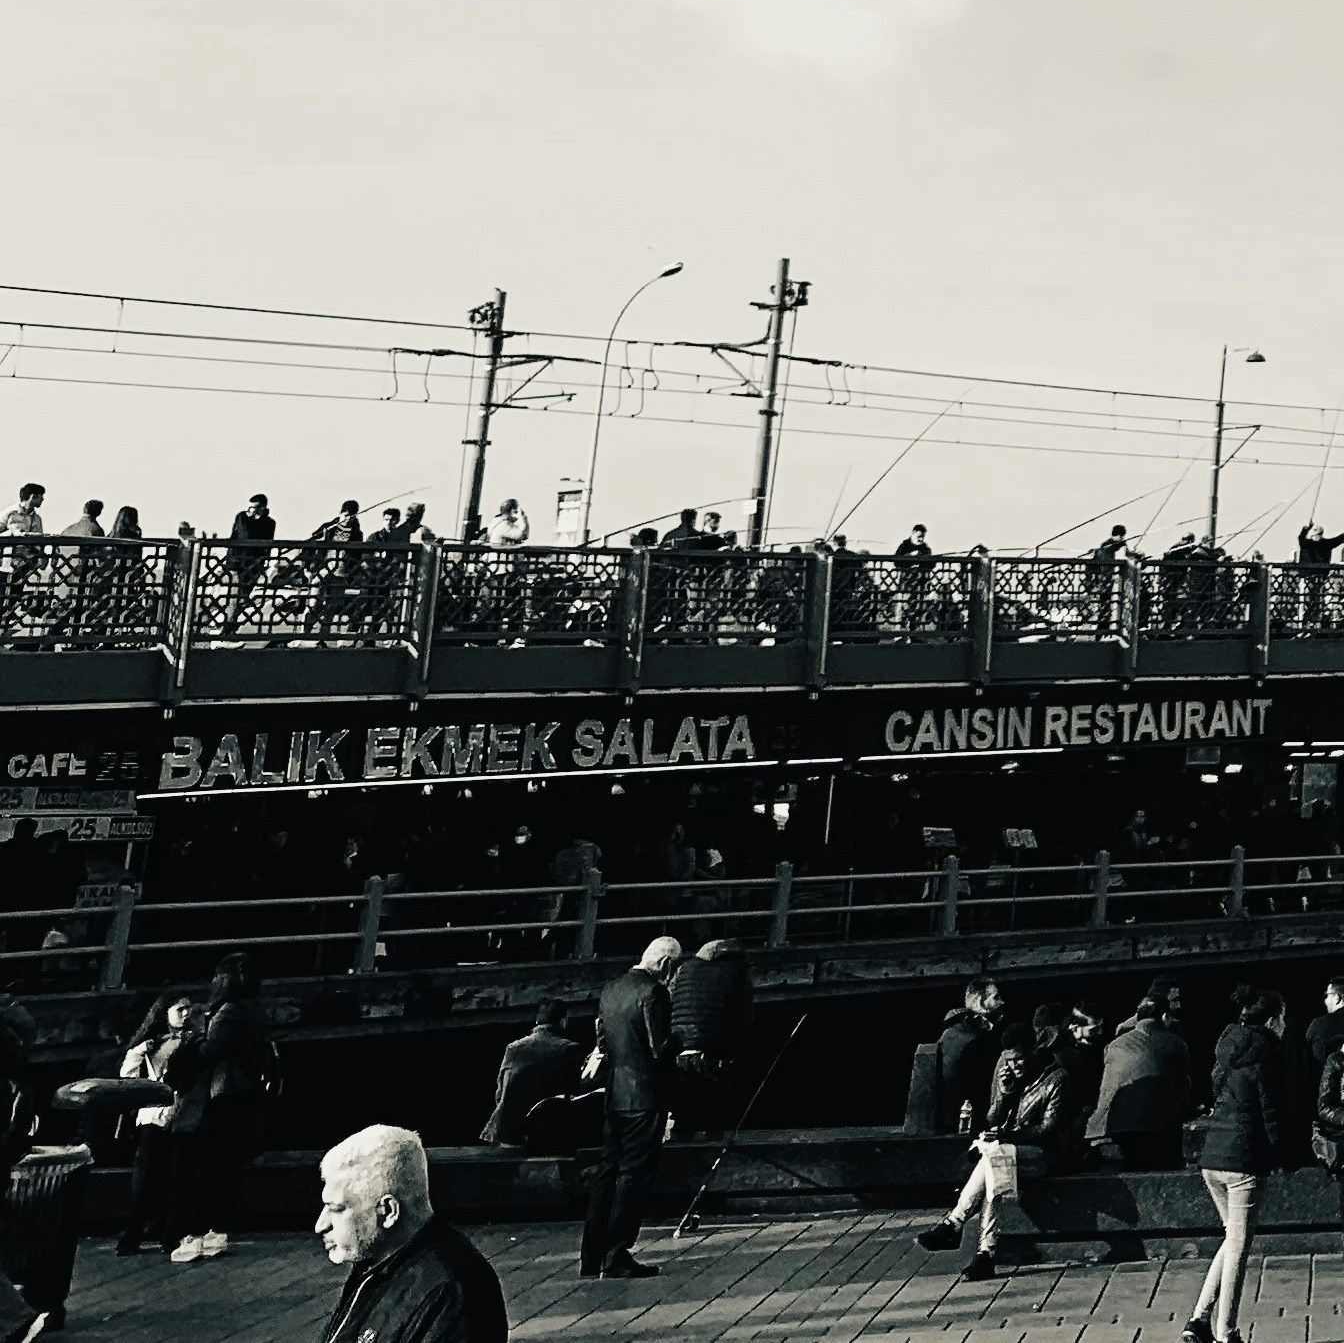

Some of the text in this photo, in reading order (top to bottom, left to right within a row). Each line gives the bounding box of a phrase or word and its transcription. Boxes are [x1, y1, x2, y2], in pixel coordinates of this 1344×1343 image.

[158, 715, 755, 790] BALIK EKMEK SALATA
[884, 697, 1273, 754] CANSIN RESTAURANT
[70, 818, 97, 839] 25
